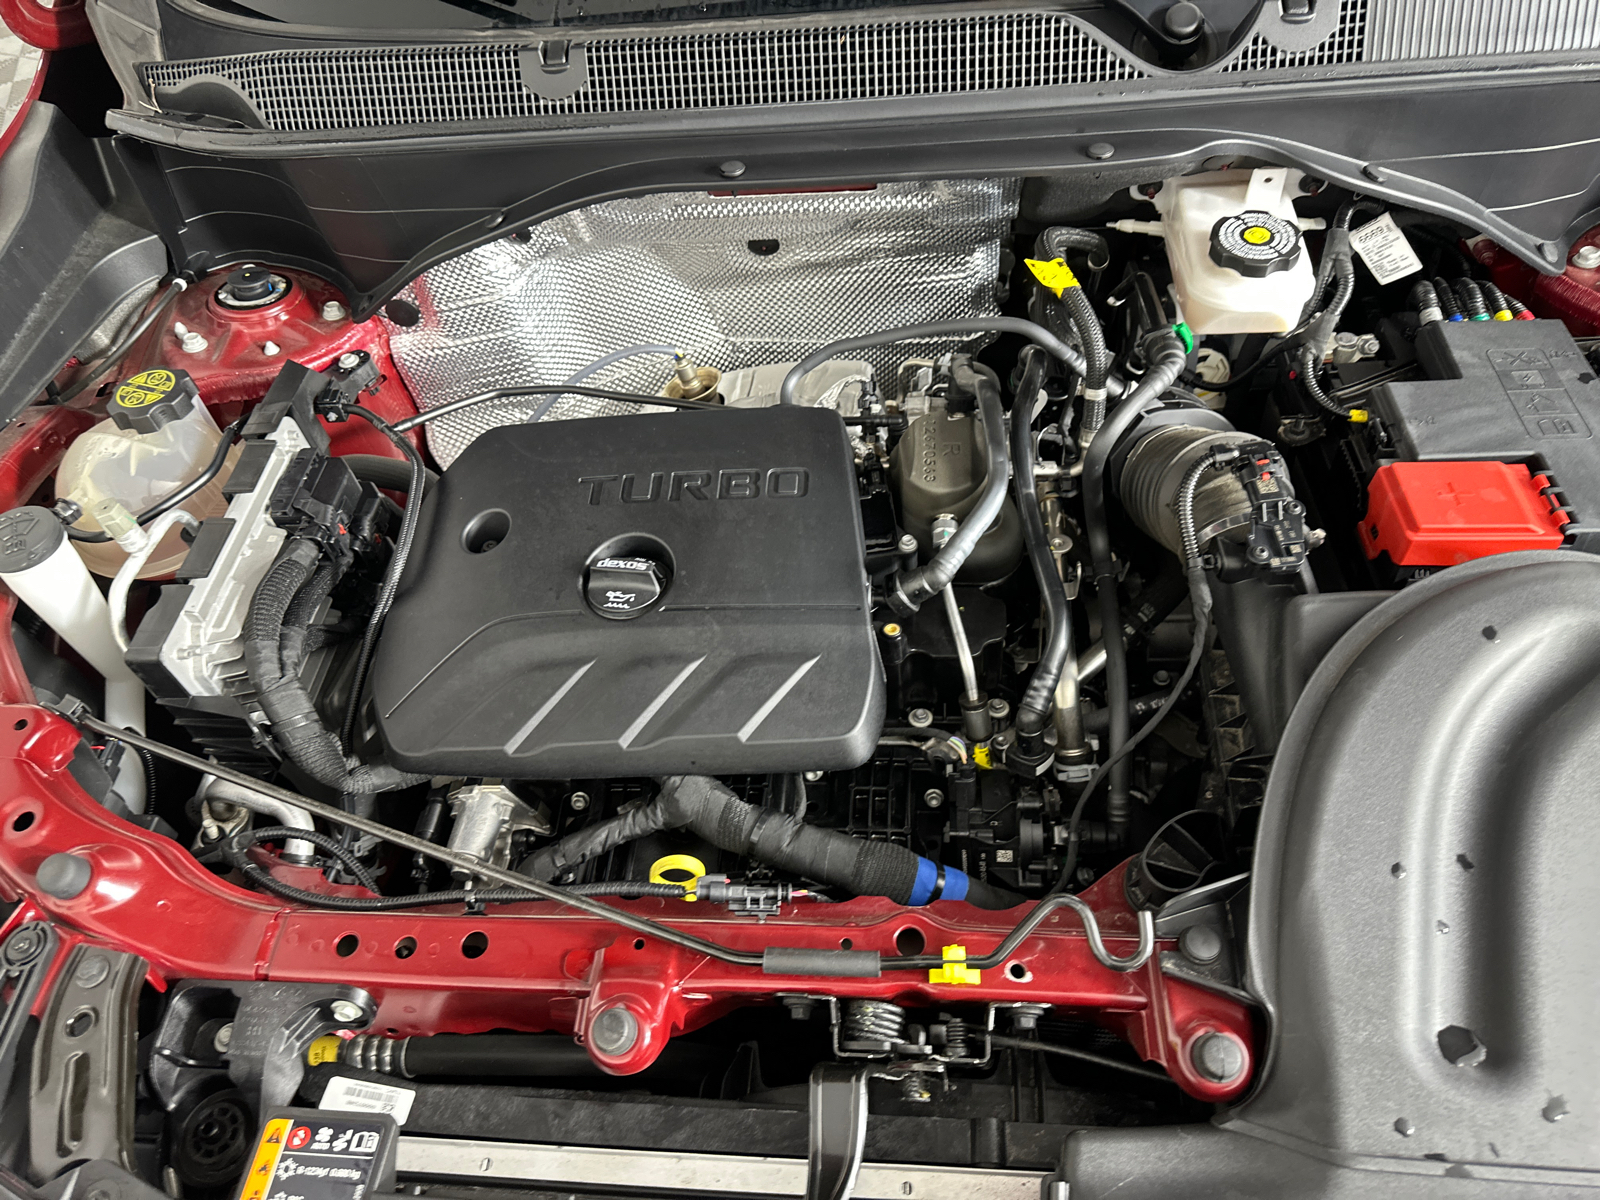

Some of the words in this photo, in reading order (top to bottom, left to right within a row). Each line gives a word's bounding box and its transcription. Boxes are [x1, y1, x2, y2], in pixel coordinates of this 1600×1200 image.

[943, 442, 961, 456] R
[578, 467, 810, 506] TURBO
[596, 557, 650, 571] dexos
